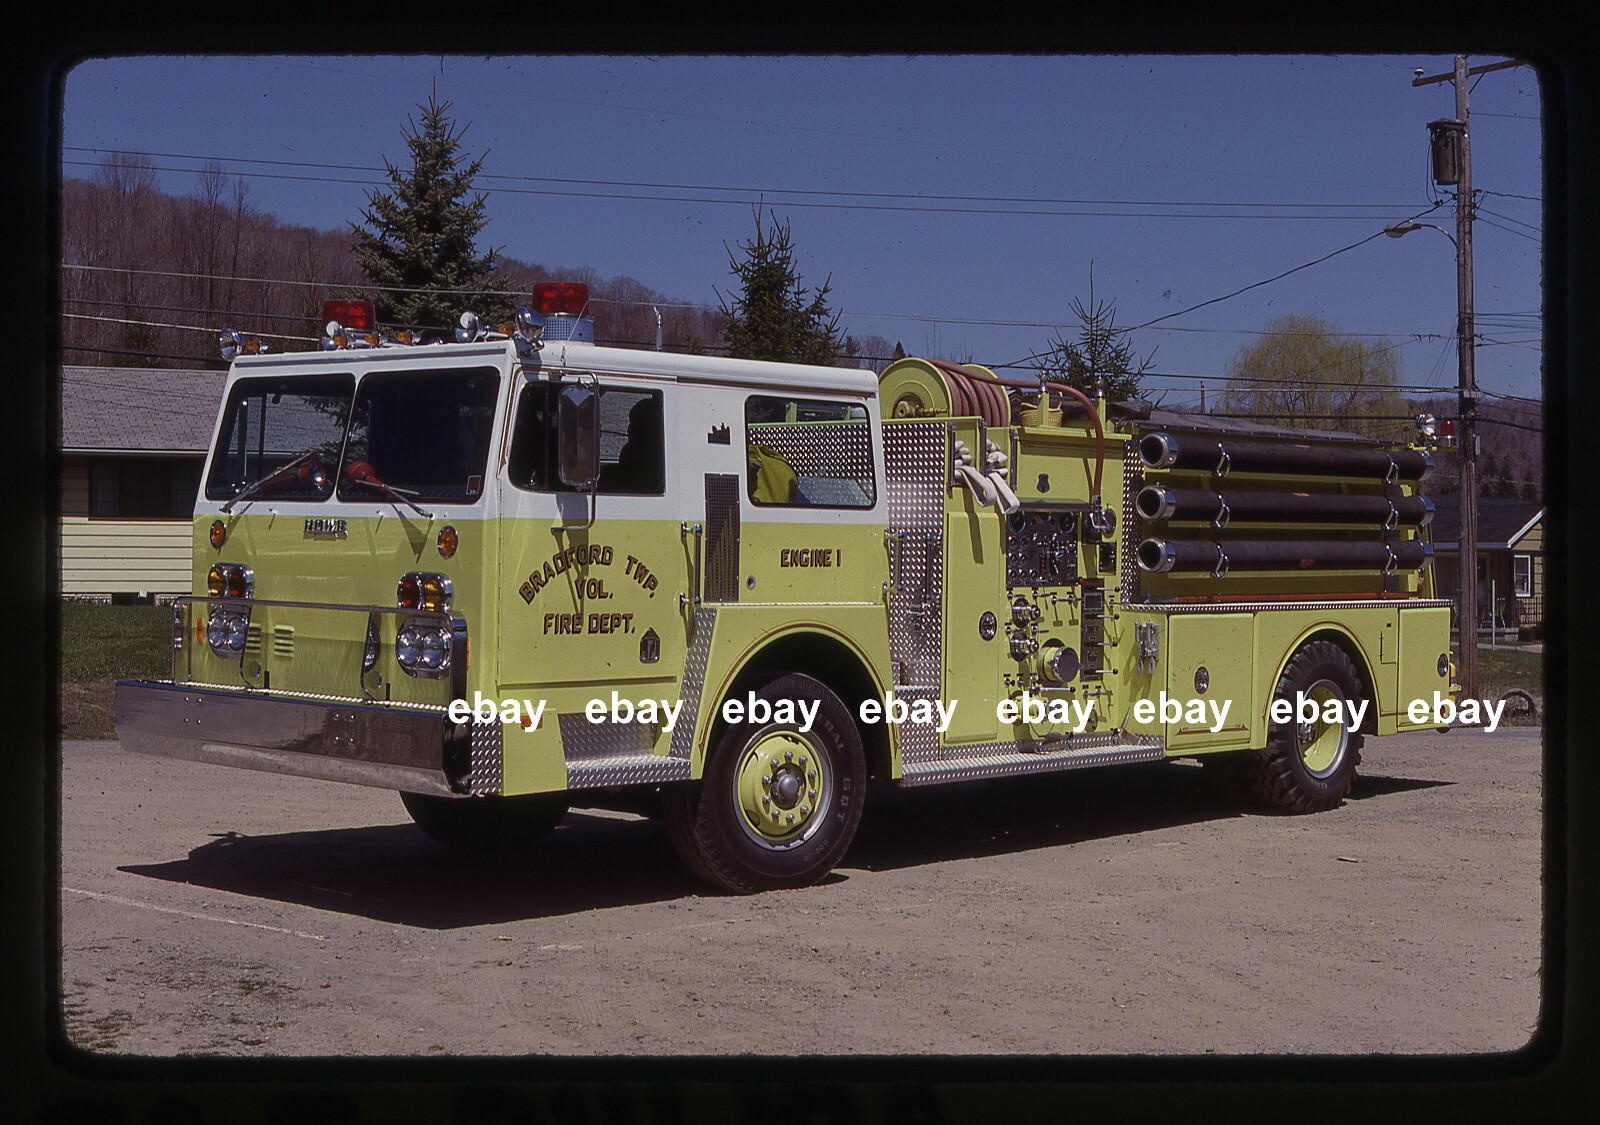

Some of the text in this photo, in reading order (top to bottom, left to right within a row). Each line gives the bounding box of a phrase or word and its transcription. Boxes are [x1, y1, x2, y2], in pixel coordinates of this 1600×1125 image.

[780, 548, 832, 567] ENGINE
[519, 544, 659, 605] BRADFORD TWP.
[574, 578, 614, 600] VOL.
[543, 612, 636, 635] FIRE DEPT.
